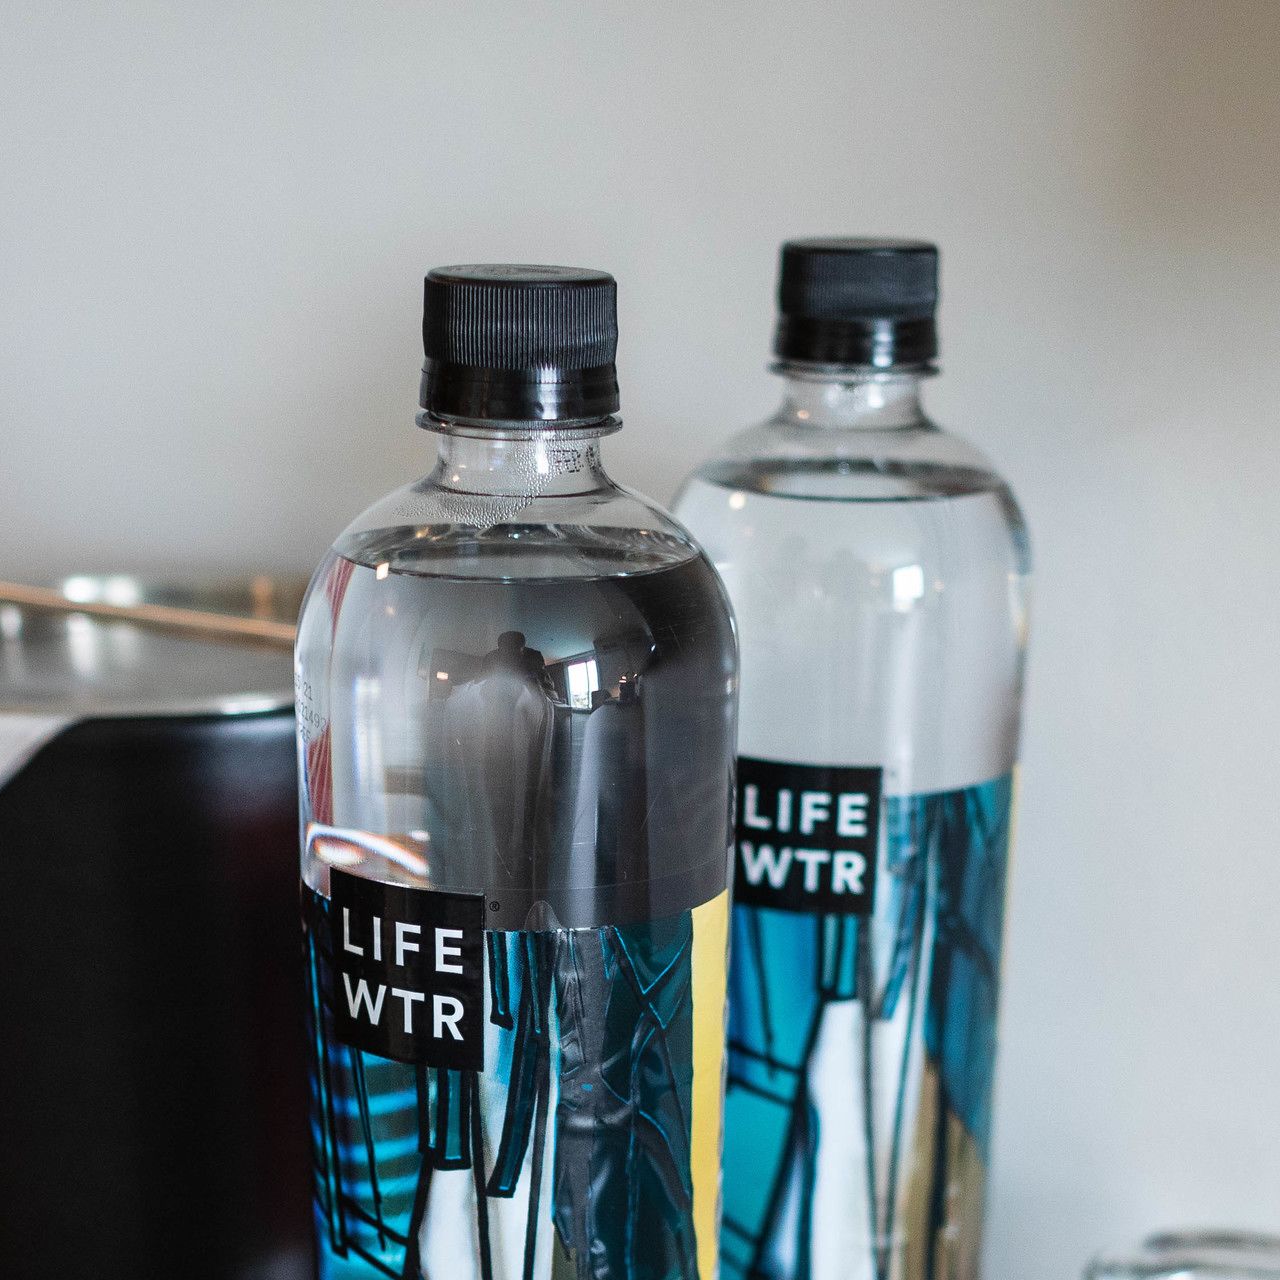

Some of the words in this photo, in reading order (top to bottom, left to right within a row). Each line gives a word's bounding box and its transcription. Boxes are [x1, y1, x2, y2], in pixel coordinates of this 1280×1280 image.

[744, 783, 869, 838] LIFE
[740, 840, 866, 895] WTR
[343, 907, 464, 975] LIFE
[342, 972, 465, 1041] WTR
